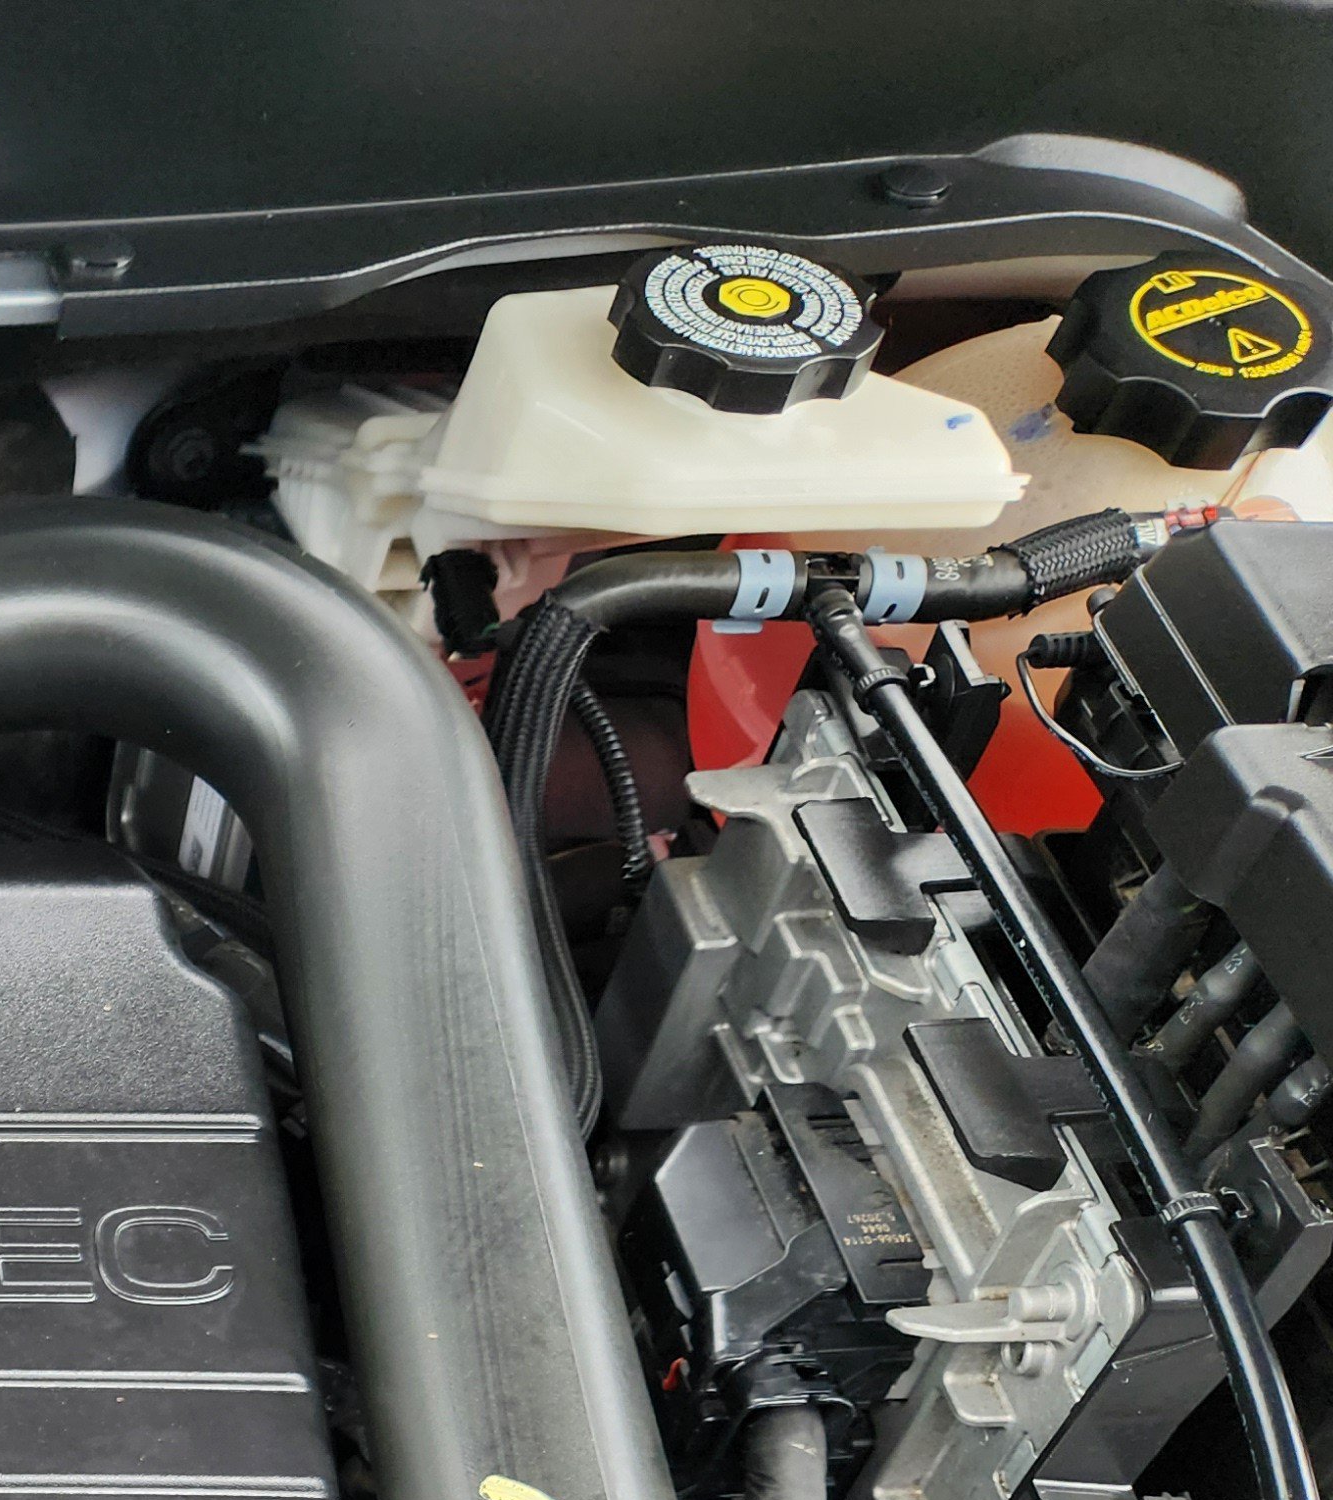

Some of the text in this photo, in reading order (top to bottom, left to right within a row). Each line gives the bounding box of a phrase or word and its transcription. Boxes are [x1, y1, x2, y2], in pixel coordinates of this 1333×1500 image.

[701, 254, 744, 267] ONLY
[743, 255, 775, 268] USE
[776, 251, 832, 278] SEALED
[713, 264, 770, 278] FILLER
[767, 269, 814, 294] CLEAN
[1146, 285, 1267, 330] ACDelco
[707, 326, 738, 343] QUE
[717, 319, 799, 337] PROVENANT
